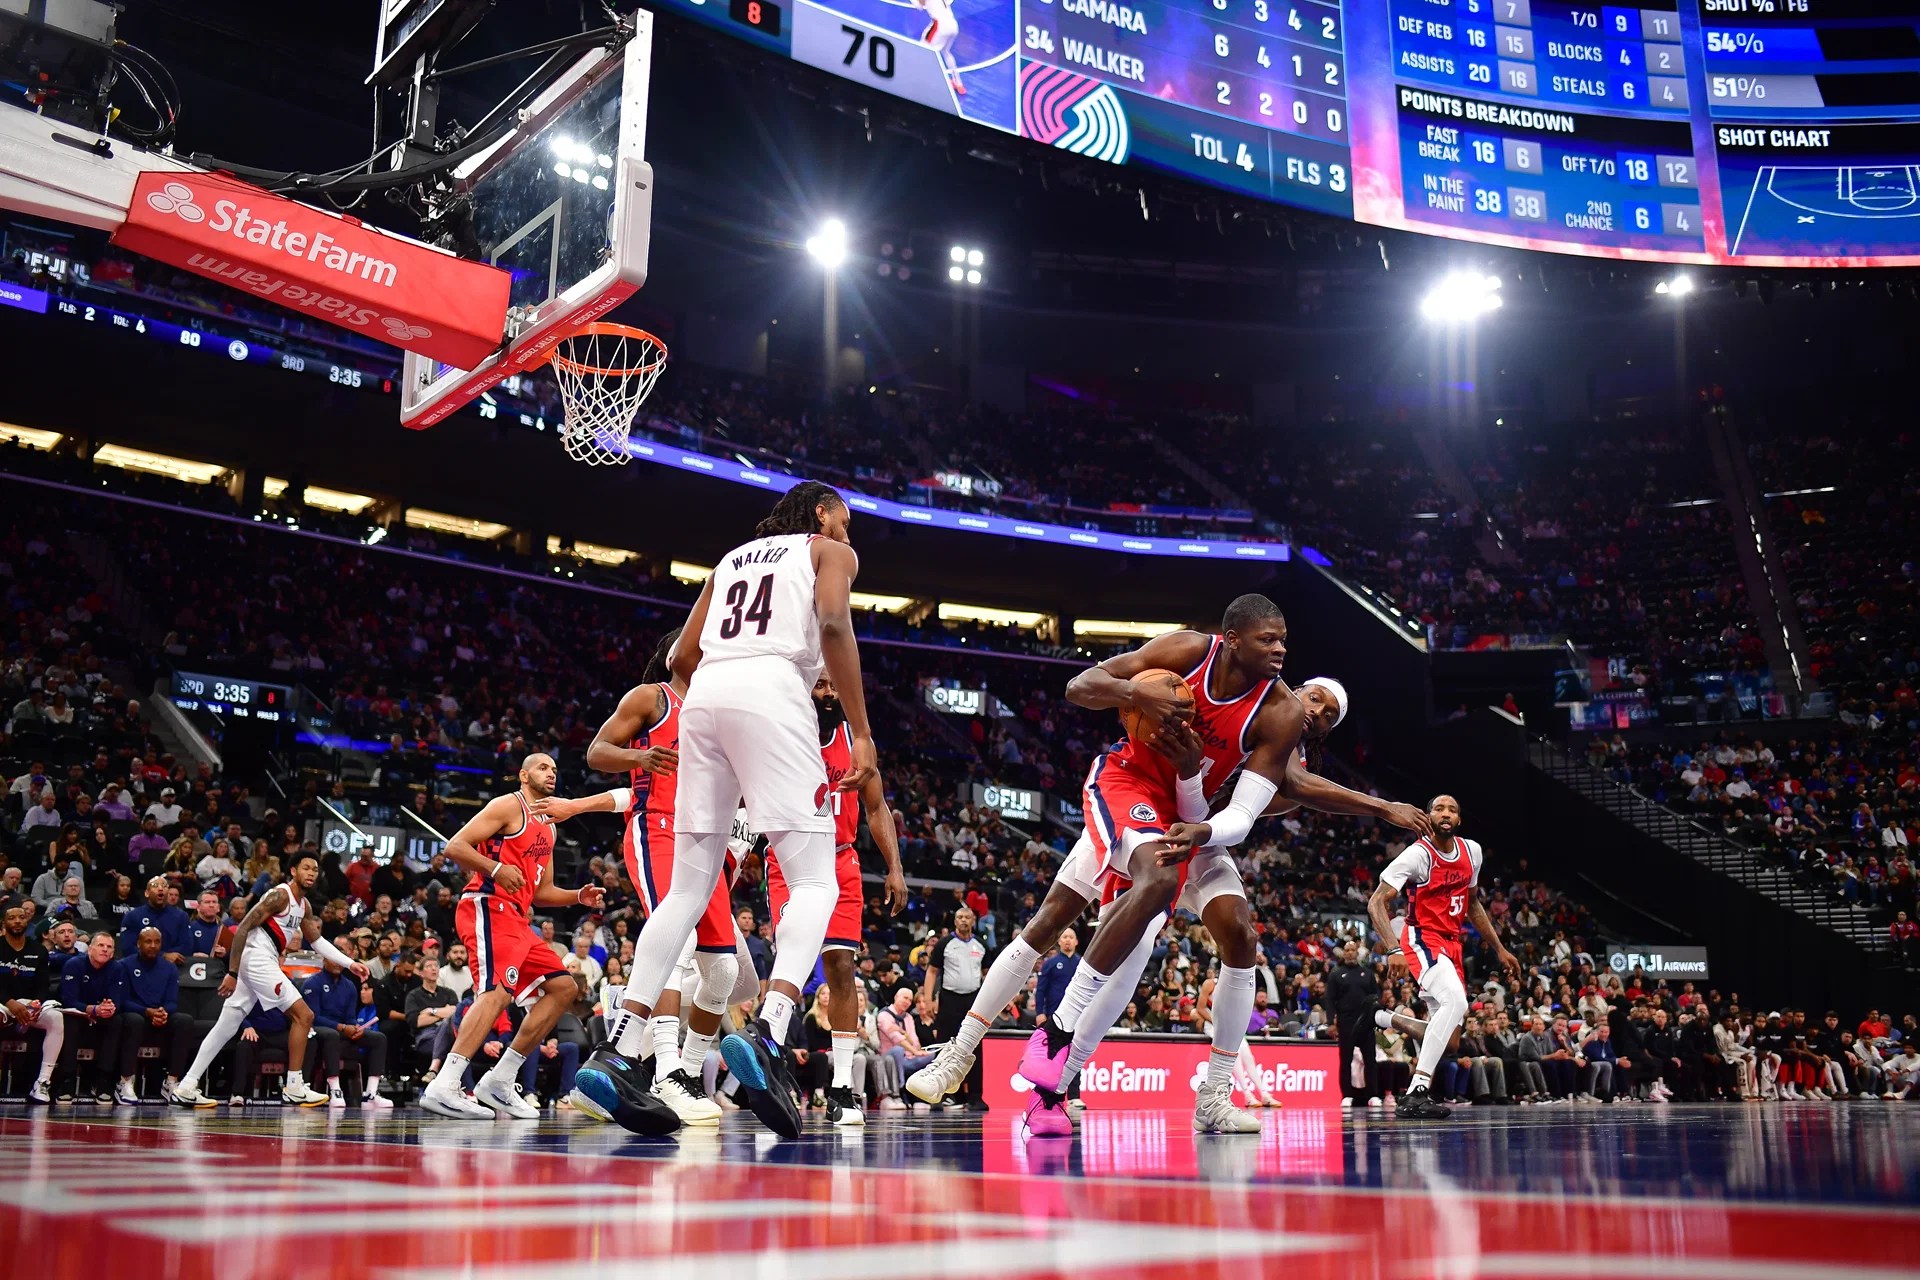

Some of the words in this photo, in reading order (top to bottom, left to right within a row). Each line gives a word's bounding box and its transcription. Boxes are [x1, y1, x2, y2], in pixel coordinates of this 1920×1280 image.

[748, 1, 761, 25] 8
[1506, 2, 1516, 18] 7
[1705, 0, 1747, 12] SHOT
[1254, 0, 1268, 22] 3
[1287, 8, 1302, 31] 4
[1321, 17, 1336, 40] 2
[1571, 11, 1597, 28] T/O
[1615, 15, 1627, 32] 9
[1653, 18, 1668, 35] 11
[1063, 0, 1147, 35] CAMARA
[1214, 33, 1229, 57] 6
[1256, 46, 1271, 68] 4
[1292, 55, 1303, 76] 1
[1324, 63, 1338, 86] 2
[1399, 15, 1423, 35] DEF
[1427, 22, 1453, 40] REB
[1467, 28, 1486, 48] 16
[1506, 35, 1524, 54] 15
[1707, 32, 1764, 54] 54%
[841, 24, 895, 79] 70
[1548, 42, 1603, 62] BLOCKS
[1620, 49, 1631, 66] 4
[1659, 52, 1671, 69] 2
[1025, 25, 1055, 54] 34
[1063, 37, 1145, 82] WALKER
[1216, 81, 1231, 105] 2
[1259, 93, 1273, 116] 2
[1293, 101, 1307, 124] 0
[1327, 109, 1341, 132] 0
[1401, 50, 1455, 75] ASSISTS
[1468, 63, 1491, 83] 20
[1509, 70, 1528, 89] 16
[1553, 75, 1606, 97] STEALS
[1623, 82, 1635, 99] 6
[1663, 85, 1674, 102] 4
[1713, 77, 1766, 99] 51%
[1401, 89, 1463, 117] POINTS
[1466, 102, 1575, 133] BREAKDOWN
[1426, 125, 1459, 145] FAST
[1718, 128, 1767, 147] SHOT
[1770, 130, 1831, 148] CHART
[1191, 133, 1228, 164] TOL
[1235, 143, 1254, 172] 4
[1287, 157, 1321, 186] FLS
[1329, 164, 1346, 193] 3
[1418, 141, 1460, 163] BREAK
[1472, 140, 1496, 164] 16
[1516, 147, 1530, 169] 6
[1562, 155, 1587, 172] OFF
[1589, 158, 1615, 176] T/O
[1625, 159, 1649, 181] 18
[1665, 162, 1689, 184] 12
[1423, 173, 1437, 191] IN
[1439, 176, 1464, 196] THE
[1428, 192, 1466, 213] PAINT
[1475, 188, 1502, 213] 38
[1514, 194, 1541, 219] 38
[1587, 200, 1612, 216] 2ND
[1565, 212, 1614, 232] CHANCE
[1635, 207, 1650, 229] 6
[1676, 211, 1689, 232] 4
[84, 306, 96, 322] 2
[135, 319, 146, 334] 4
[180, 330, 201, 347] 80
[281, 354, 305, 372] 3RD
[329, 365, 362, 388] 3:35
[480, 402, 497, 419] 70
[732, 547, 789, 571] WALKER
[720, 573, 774, 640] 34
[214, 682, 250, 704] 3:35
[948, 689, 979, 708] FIJI
[1000, 788, 1031, 811] FIJI
[533, 863, 545, 886] 3
[1448, 895, 1465, 917] 55
[1627, 953, 1663, 972] FIJI
[1664, 961, 1706, 973] AIRWAYS
